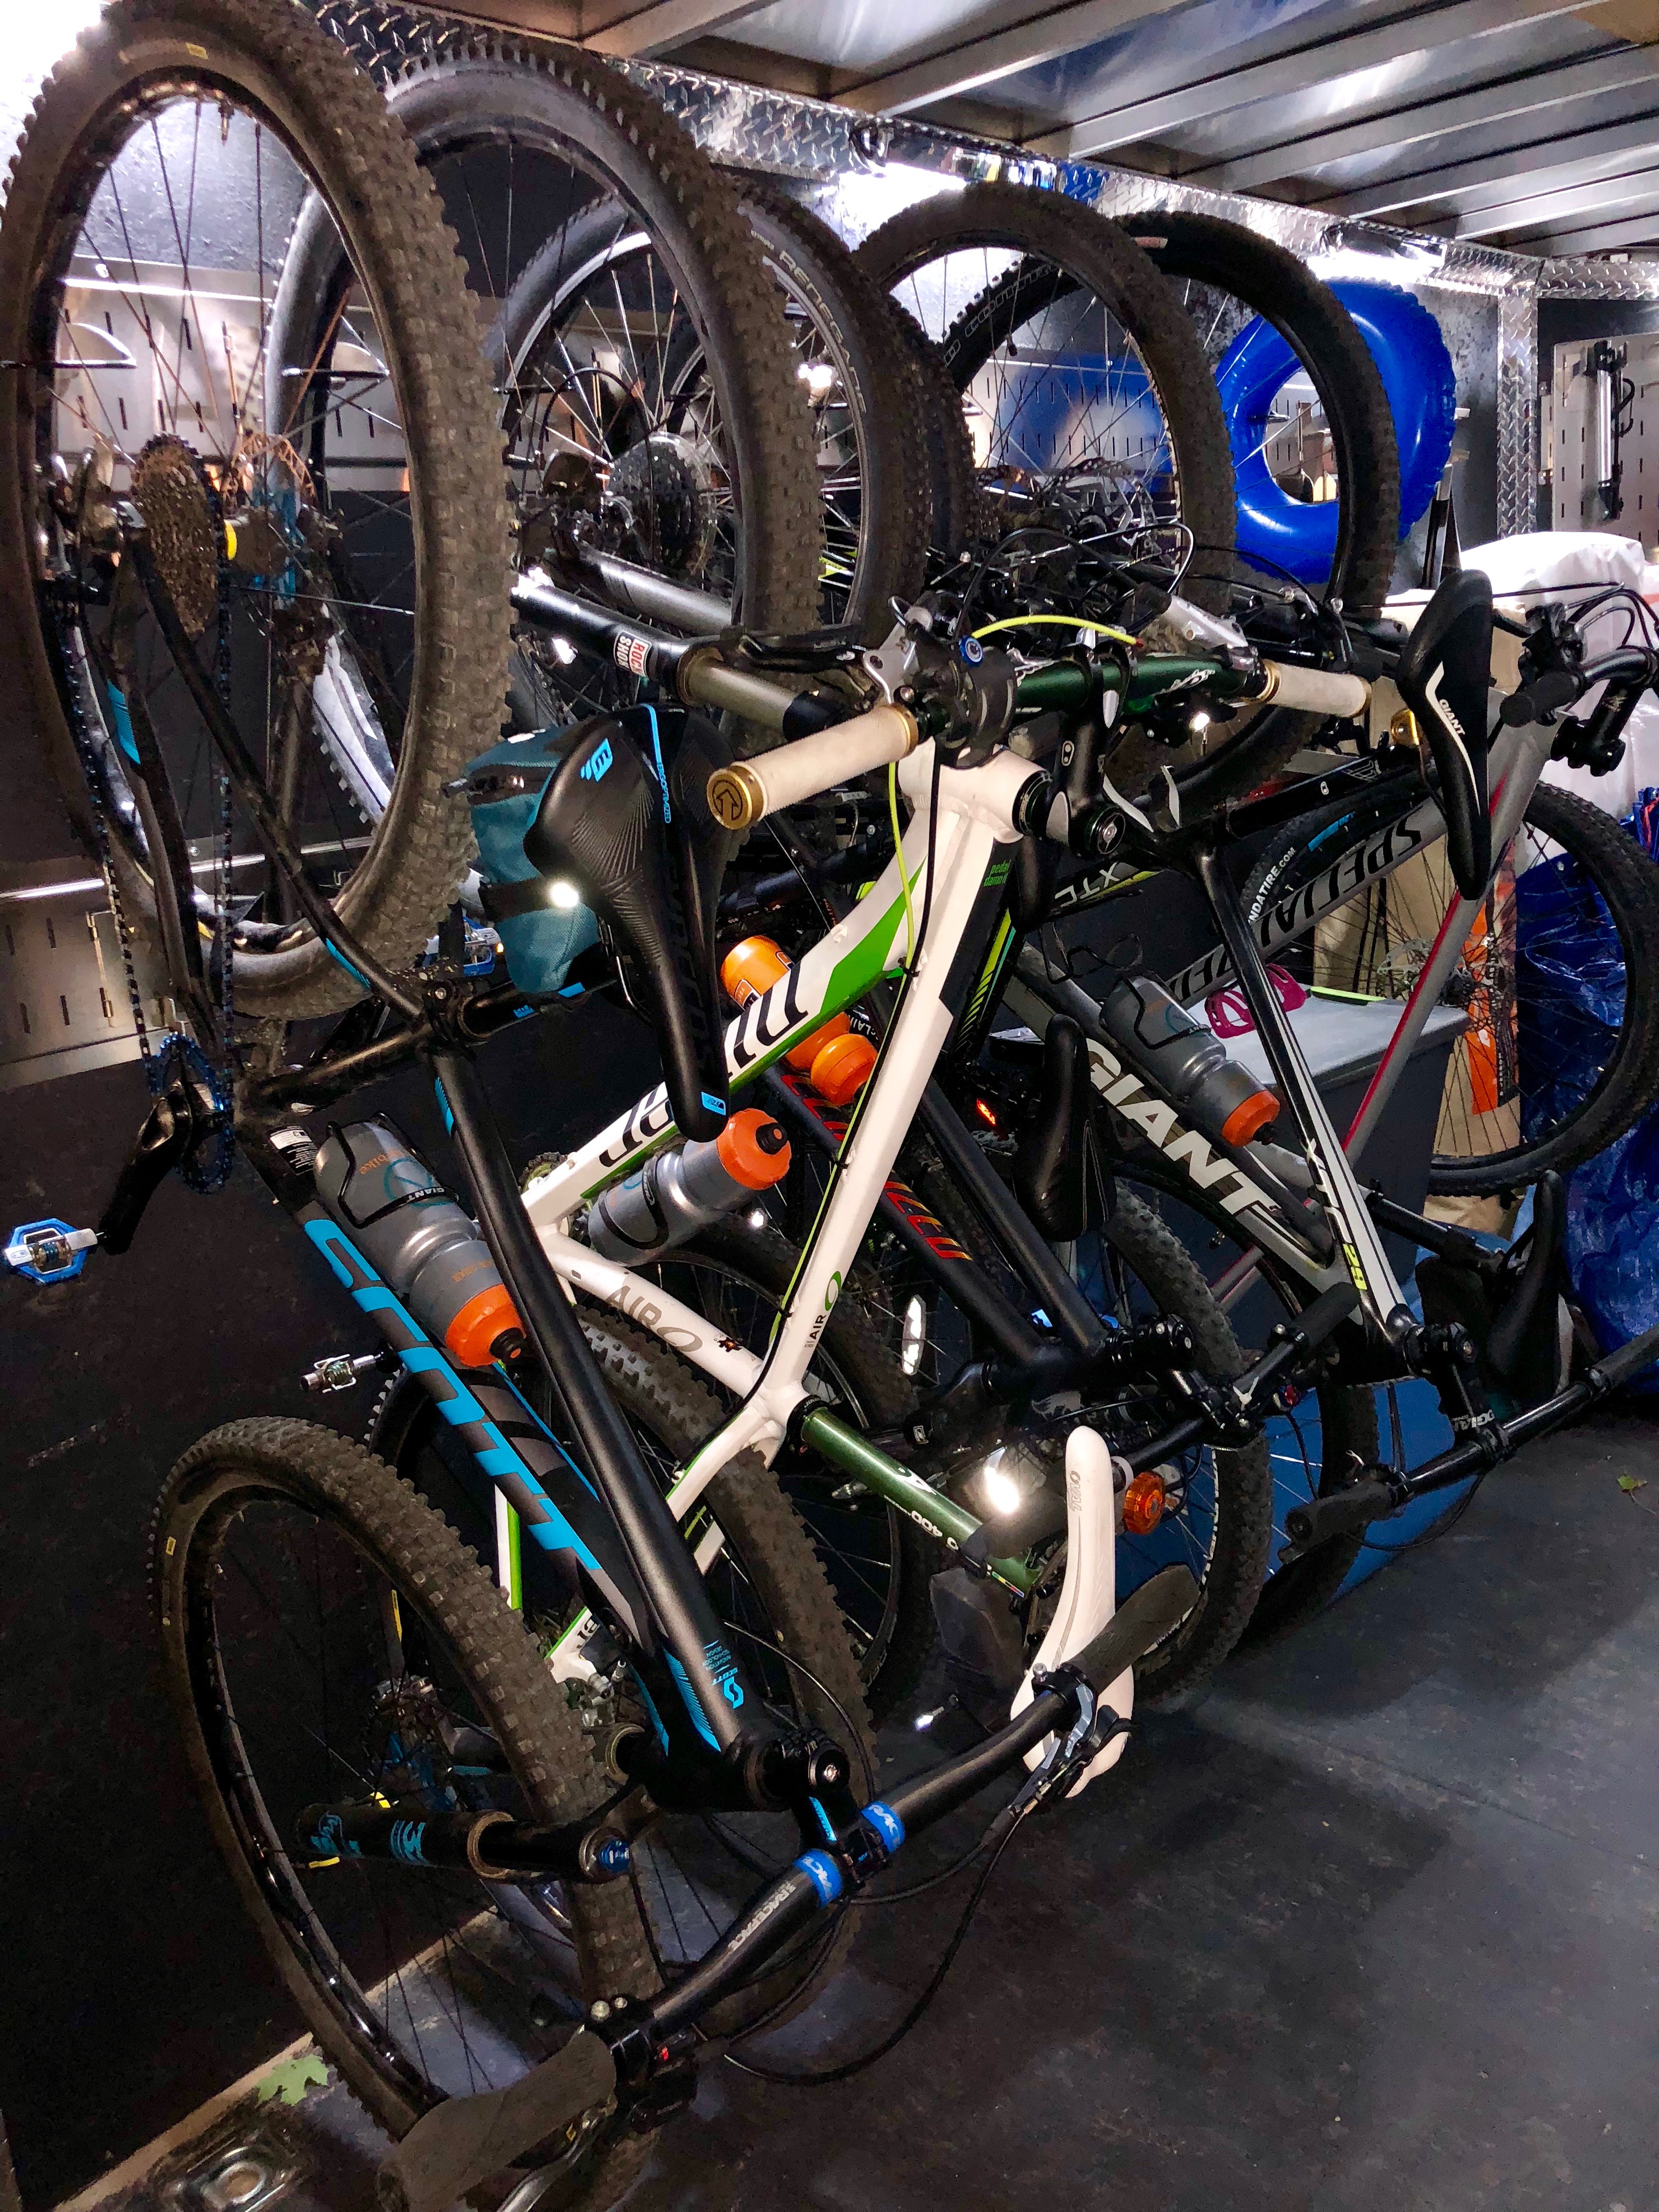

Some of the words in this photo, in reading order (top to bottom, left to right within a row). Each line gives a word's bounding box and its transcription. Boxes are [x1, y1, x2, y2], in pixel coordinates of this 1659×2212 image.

[616, 635, 631, 669] SHOX
[1439, 698, 1466, 736] GIANT
[990, 859, 1011, 876] pedal
[1054, 860, 1120, 908] XTC
[1085, 1037, 1281, 1219] GIANT
[408, 1186, 445, 1204] GIANT
[1342, 1243, 1366, 1290] 29
[607, 1284, 663, 1329] AIR
[808, 1314, 827, 1340] AIR
[1068, 1470, 1082, 1512] OVAL
[712, 1667, 739, 1686] SCOTT
[727, 1887, 791, 1953] RACEFACE
